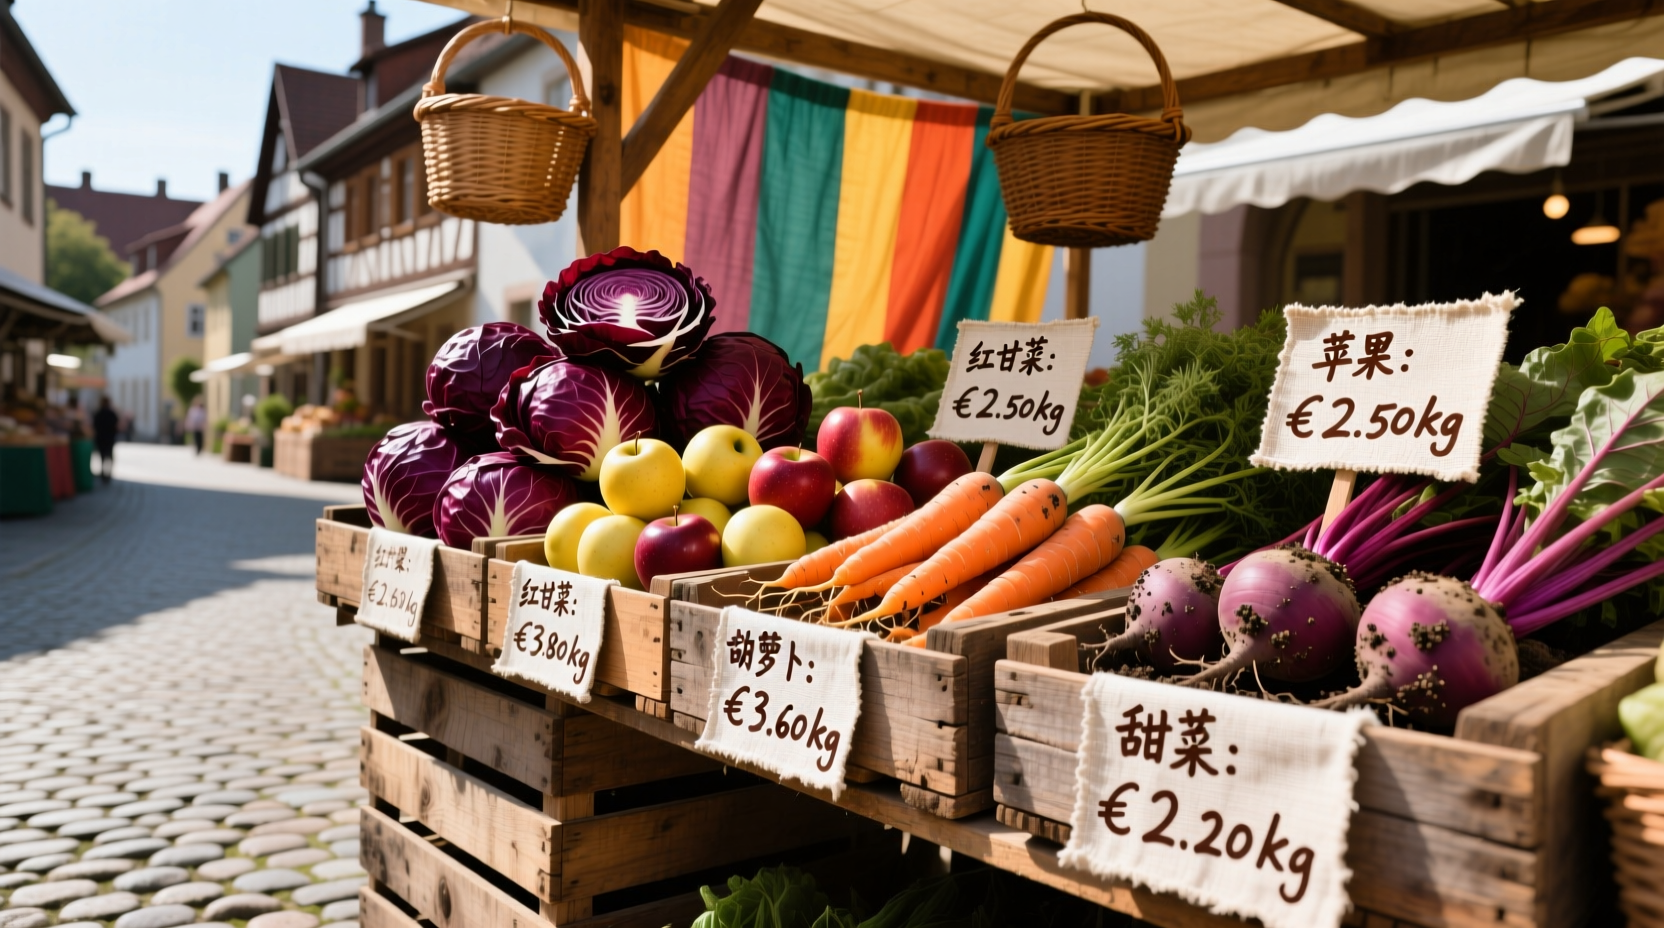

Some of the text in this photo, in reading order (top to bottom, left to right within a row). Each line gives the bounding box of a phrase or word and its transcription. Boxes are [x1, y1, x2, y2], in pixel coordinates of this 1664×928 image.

[966, 336, 1056, 376] 红甘菜：
[1311, 329, 1414, 382] 苹果：
[952, 386, 1065, 436] €2.50kg
[1285, 395, 1464, 457] €2.50kg
[513, 621, 590, 685] €3.80kg
[726, 628, 815, 684] 胡萝卜：
[723, 685, 841, 772] €3.60kg
[1115, 704, 1238, 777] 甜菜：
[1097, 782, 1315, 903] €2.20kg
